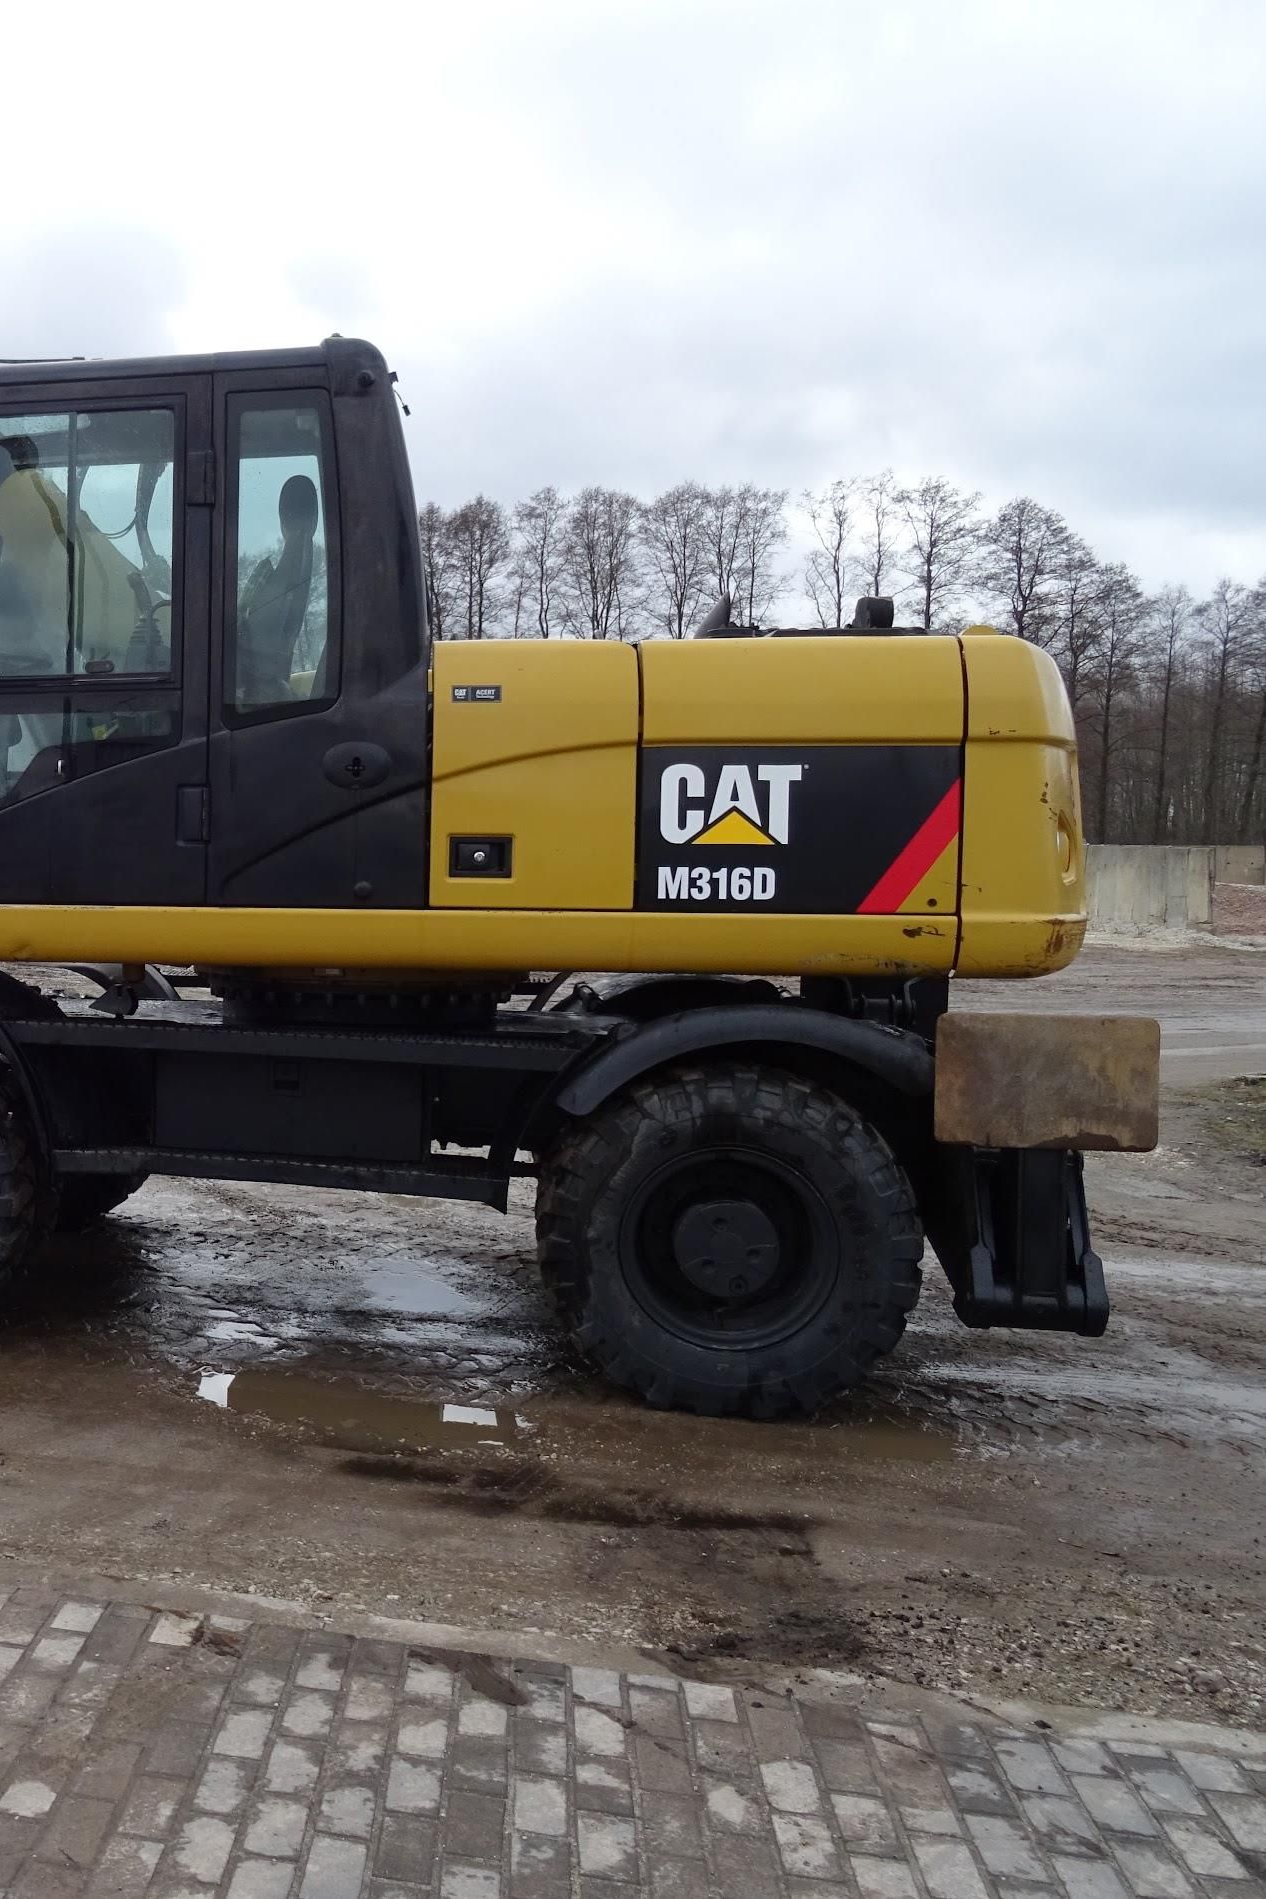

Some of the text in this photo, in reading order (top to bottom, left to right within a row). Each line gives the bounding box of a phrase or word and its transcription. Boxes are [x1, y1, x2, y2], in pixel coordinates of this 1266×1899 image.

[454, 688, 467, 696] CAT
[659, 763, 803, 845] CAT
[657, 866, 776, 901] M316D
